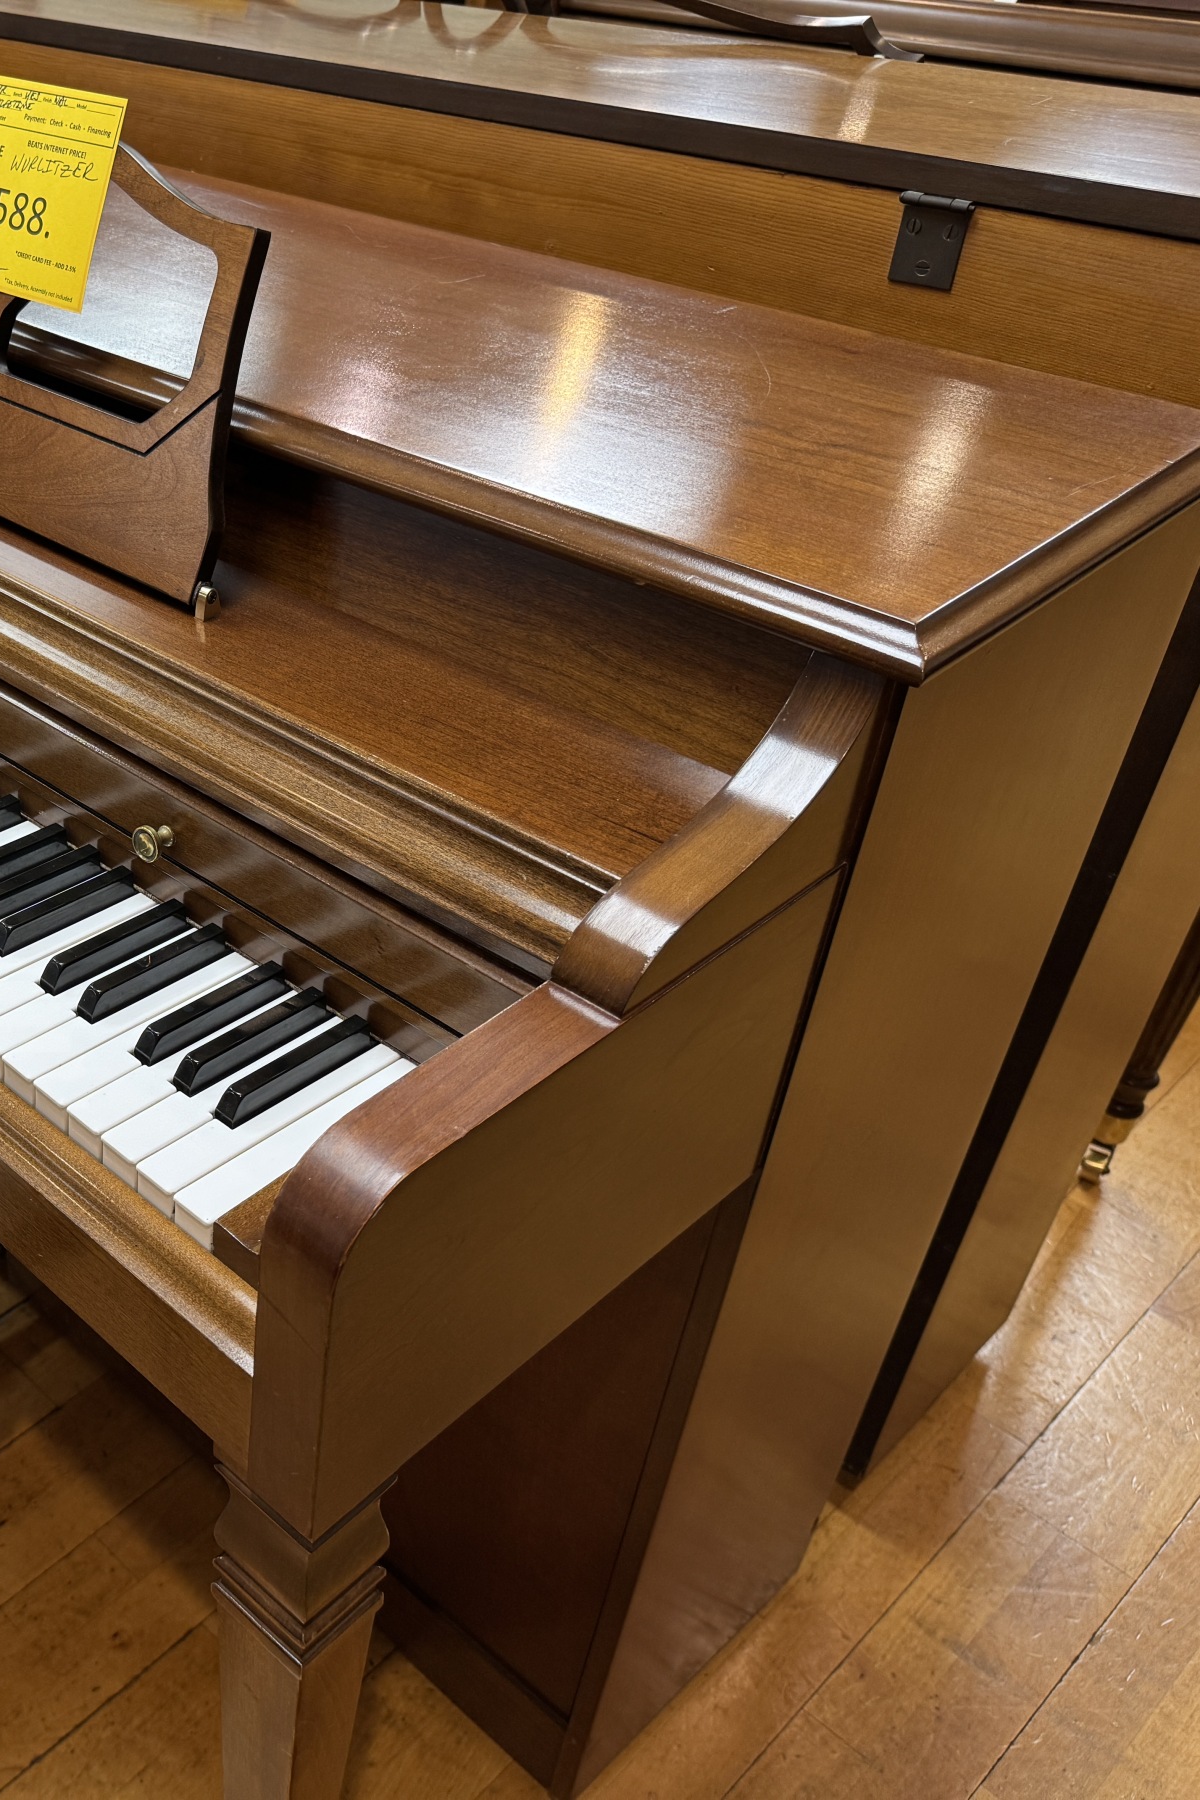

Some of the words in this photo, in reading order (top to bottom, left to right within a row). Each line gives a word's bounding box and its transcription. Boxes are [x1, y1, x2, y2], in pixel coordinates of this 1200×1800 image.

[50, 119, 63, 127] Check
[70, 123, 81, 131] Cash
[87, 126, 111, 138] Financing
[27, 140, 43, 150] BEATS
[44, 143, 69, 155] INTERNET
[10, 153, 98, 181] WURLITZER
[32, 255, 44, 264] CARD
